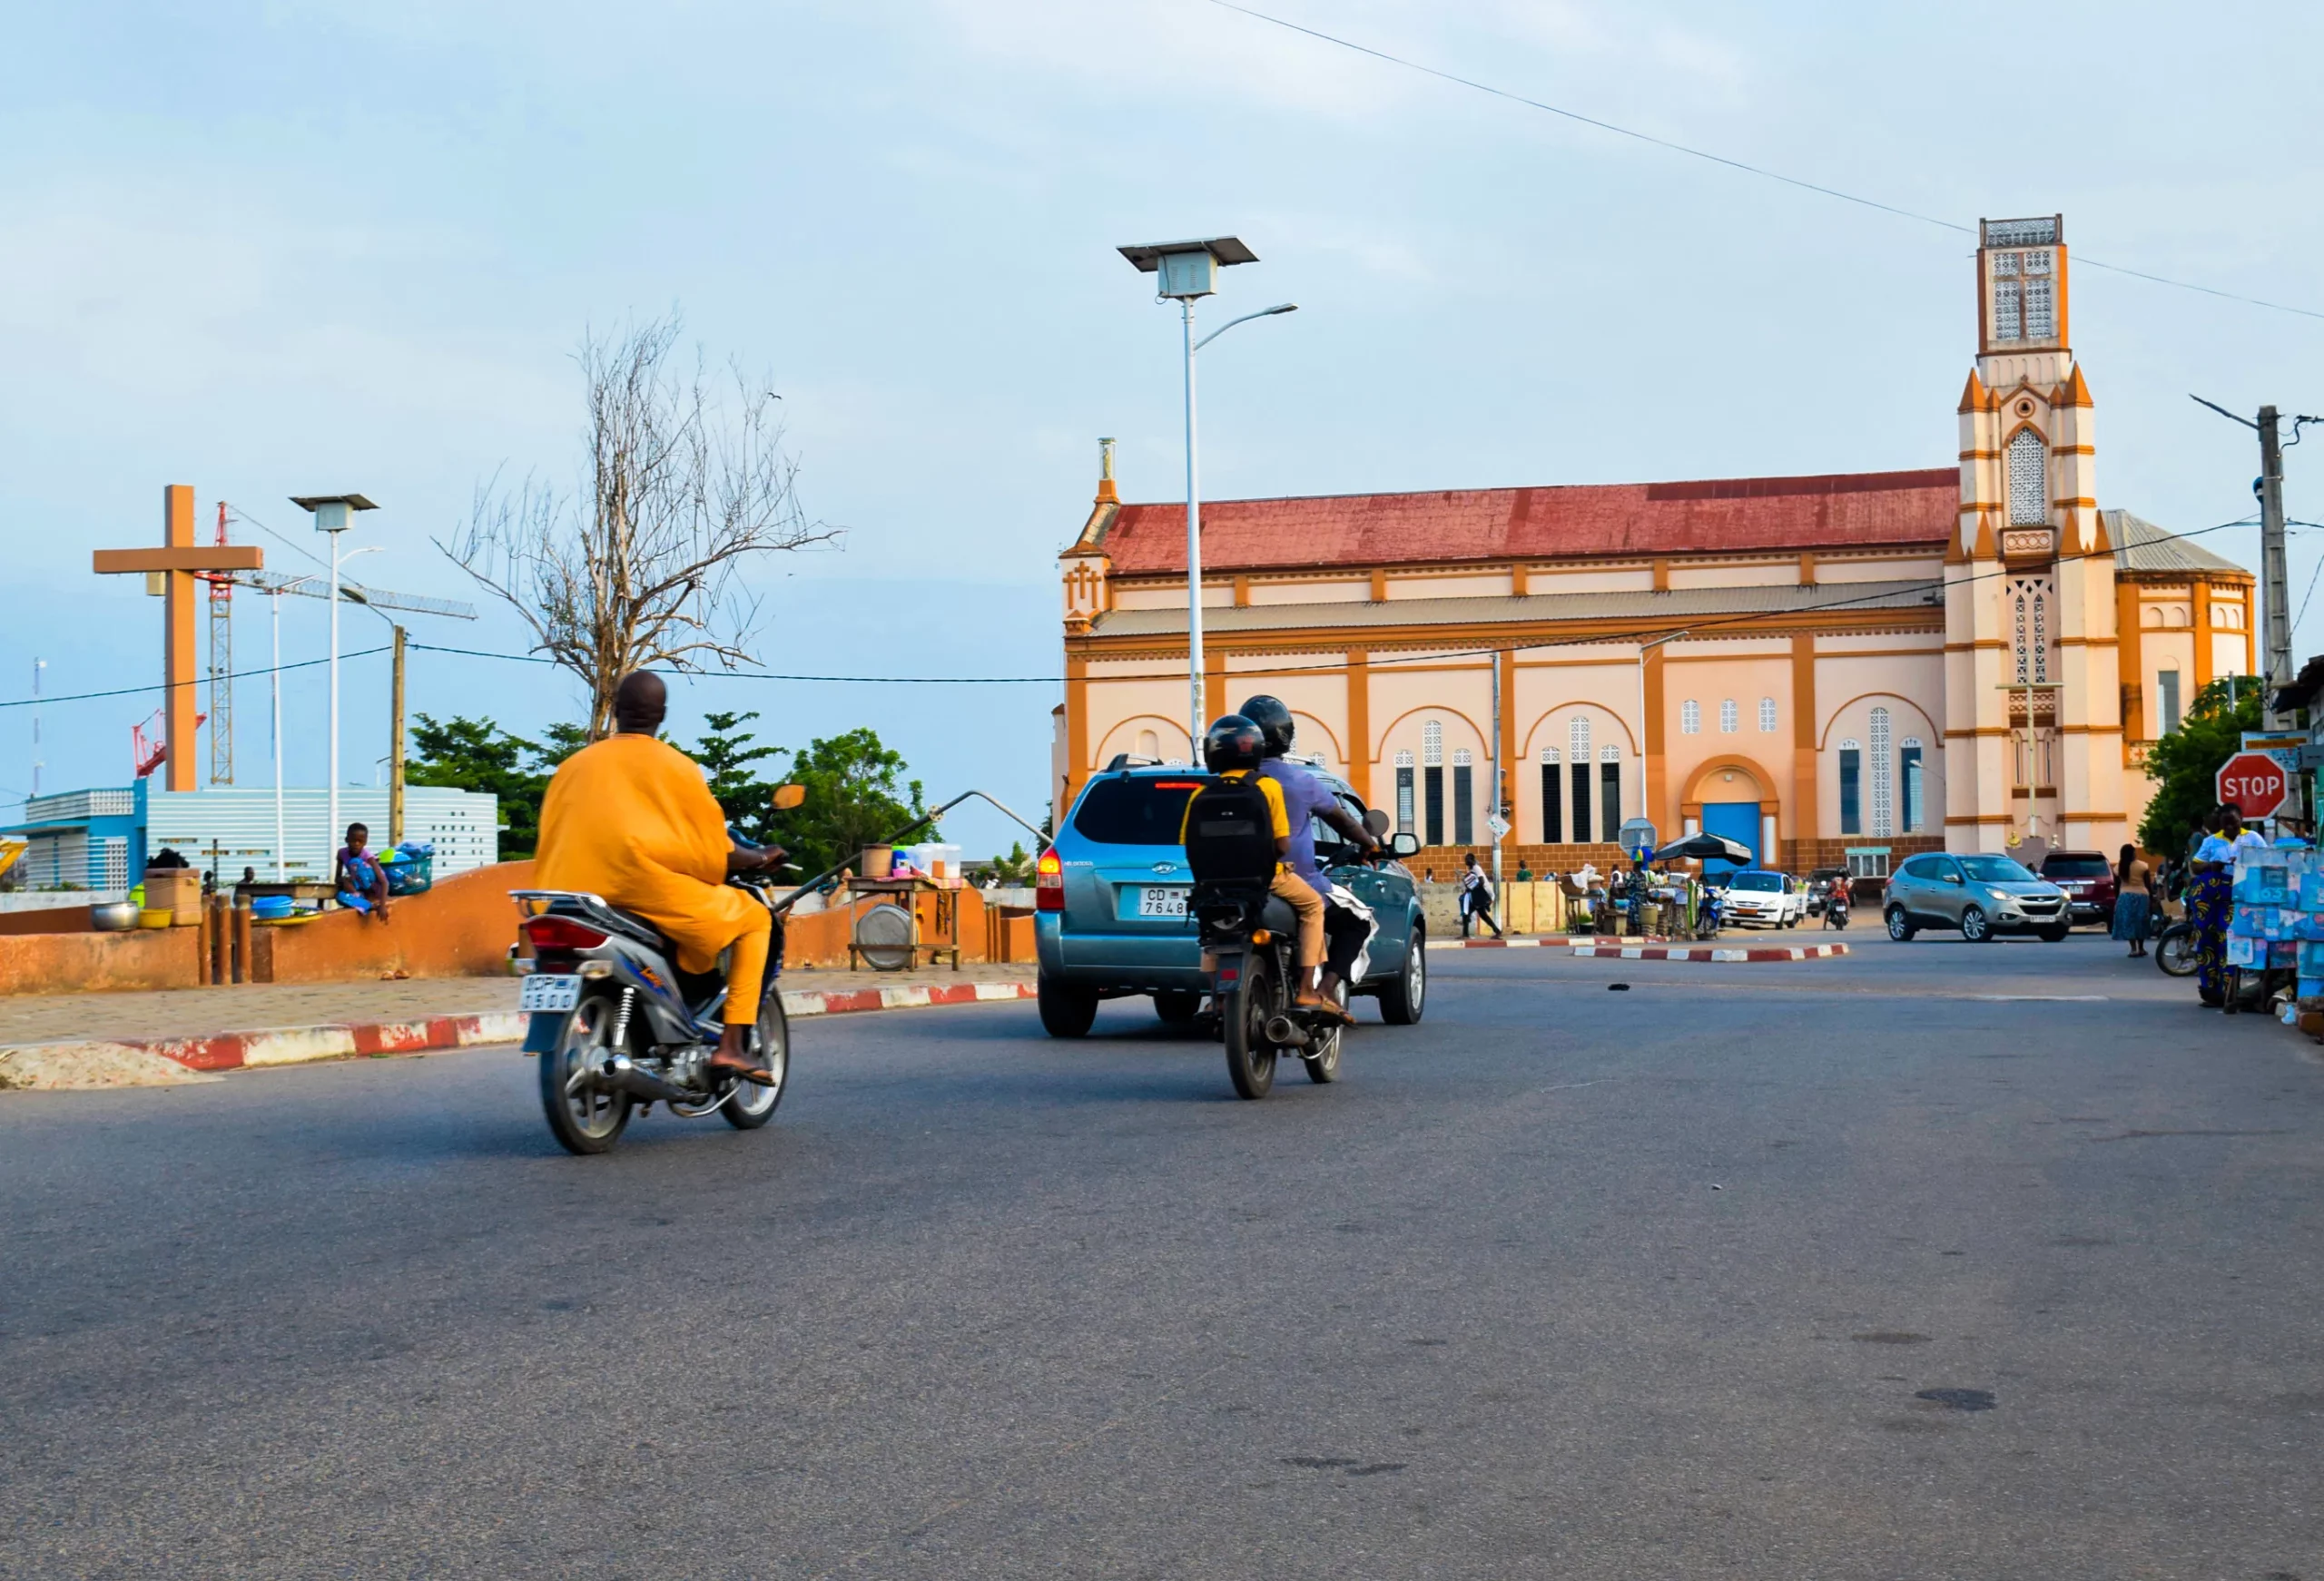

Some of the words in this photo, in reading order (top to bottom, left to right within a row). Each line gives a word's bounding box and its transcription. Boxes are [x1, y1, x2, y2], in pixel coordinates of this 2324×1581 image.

[2224, 776, 2280, 797] STOP
[1147, 889, 1166, 901] CD
[1146, 902, 1184, 914] 7648
